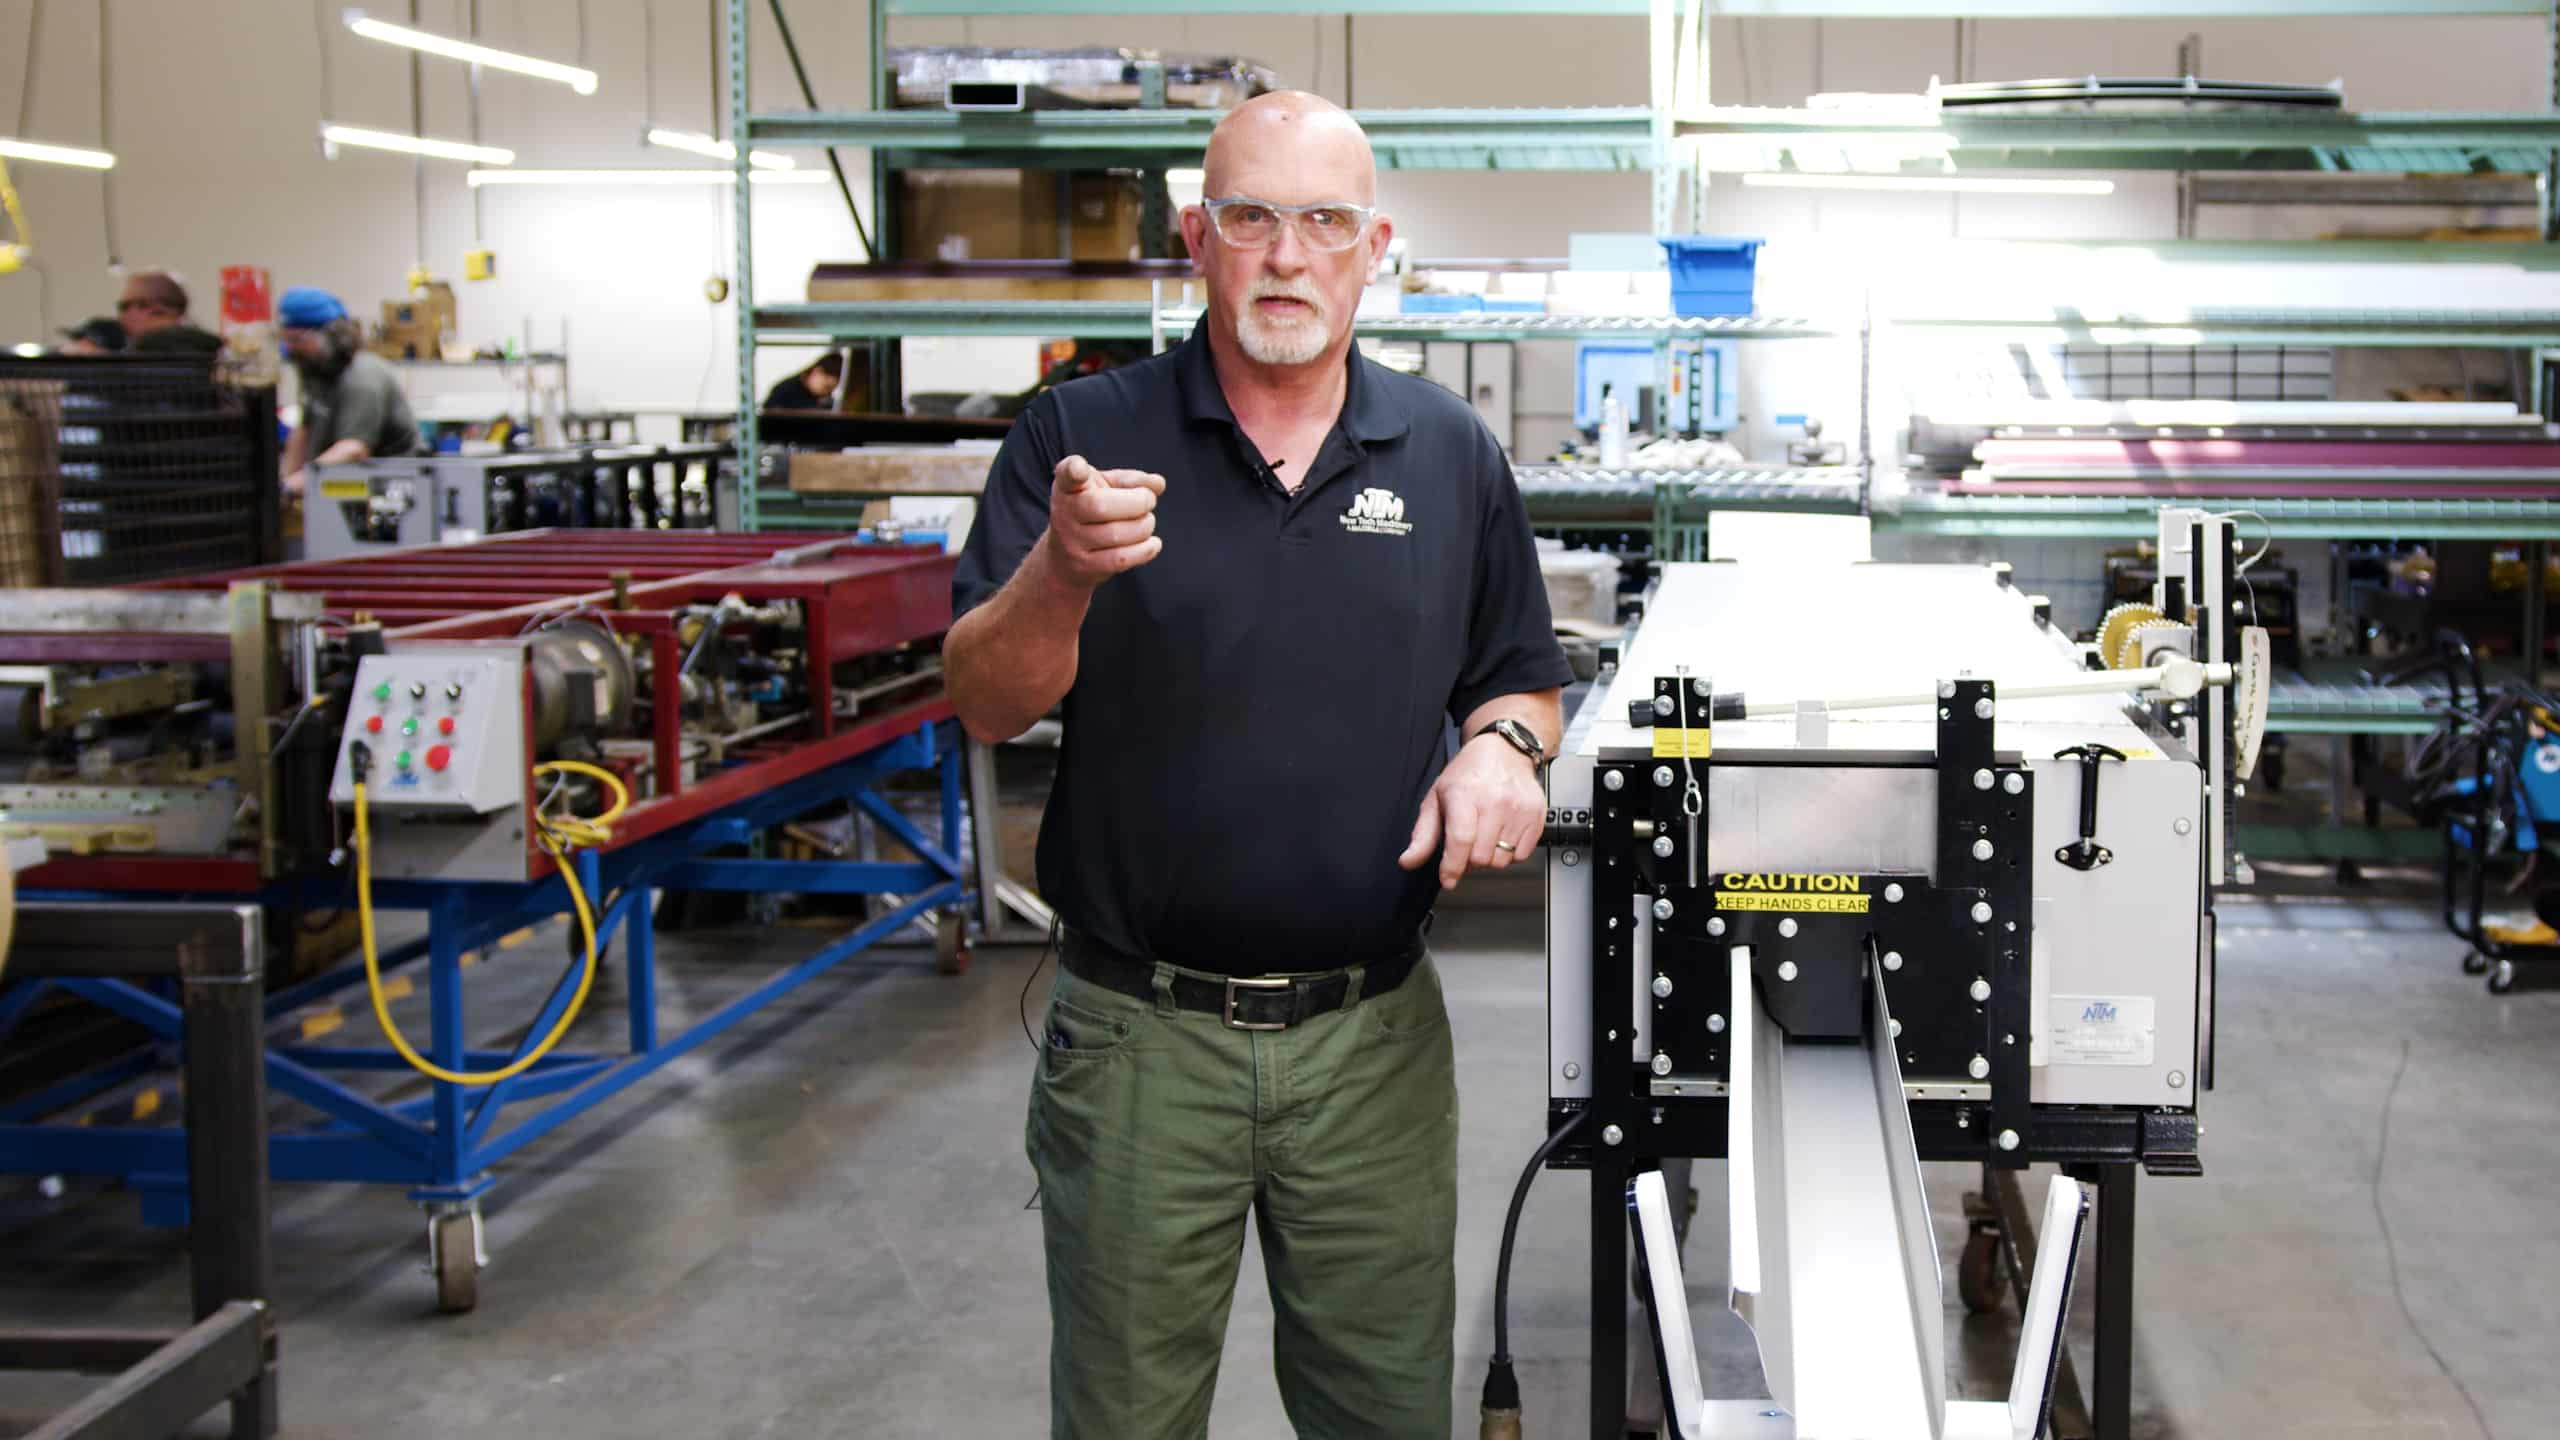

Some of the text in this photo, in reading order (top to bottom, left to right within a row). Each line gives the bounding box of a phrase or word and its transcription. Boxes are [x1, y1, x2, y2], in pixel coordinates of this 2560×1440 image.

[1348, 487, 1404, 521] NTM
[1723, 872, 1860, 892] CAUTION
[1716, 896, 1868, 912] KEEP HANDS CLEAR
[2081, 1001, 2118, 1021] NTM
